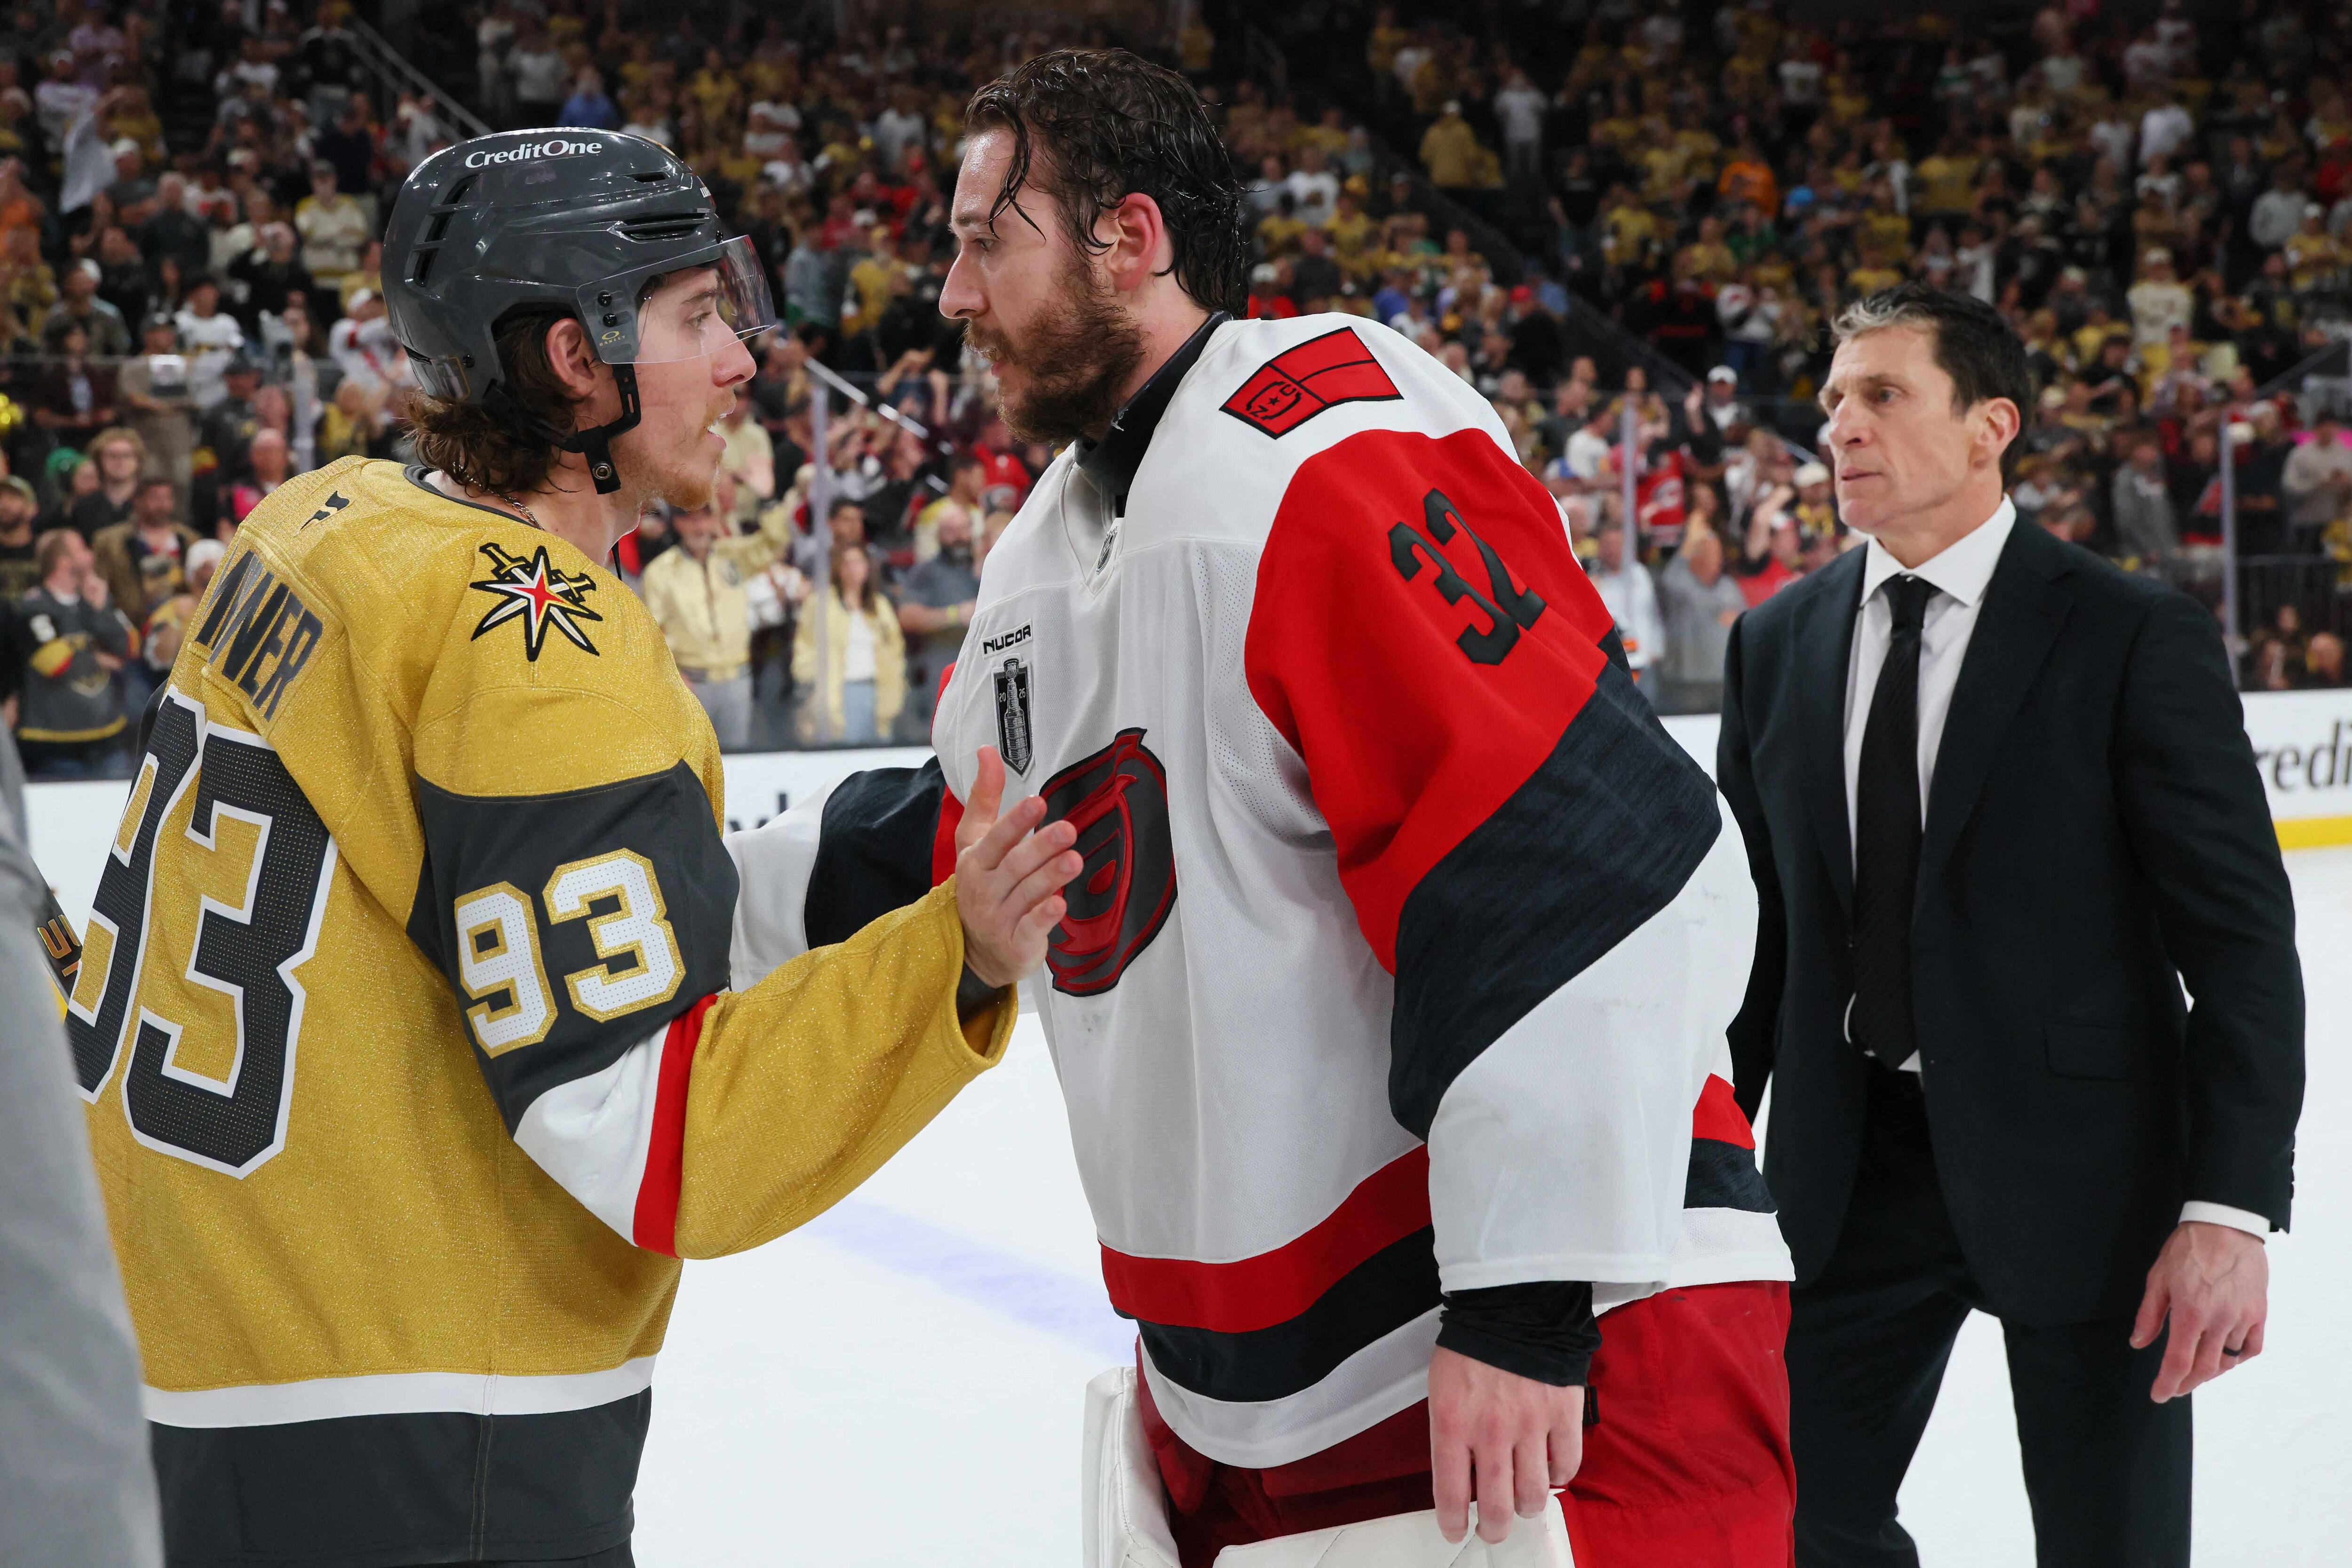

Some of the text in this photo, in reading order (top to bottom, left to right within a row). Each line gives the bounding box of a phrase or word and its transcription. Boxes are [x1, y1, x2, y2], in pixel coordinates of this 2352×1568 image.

[465, 140, 602, 168] CreditOne
[1387, 487, 1547, 666] 32
[983, 624, 1031, 654] NUCOR
[999, 688, 1026, 702] 20 26
[65, 684, 340, 1180] 93
[454, 847, 687, 1059] 93
